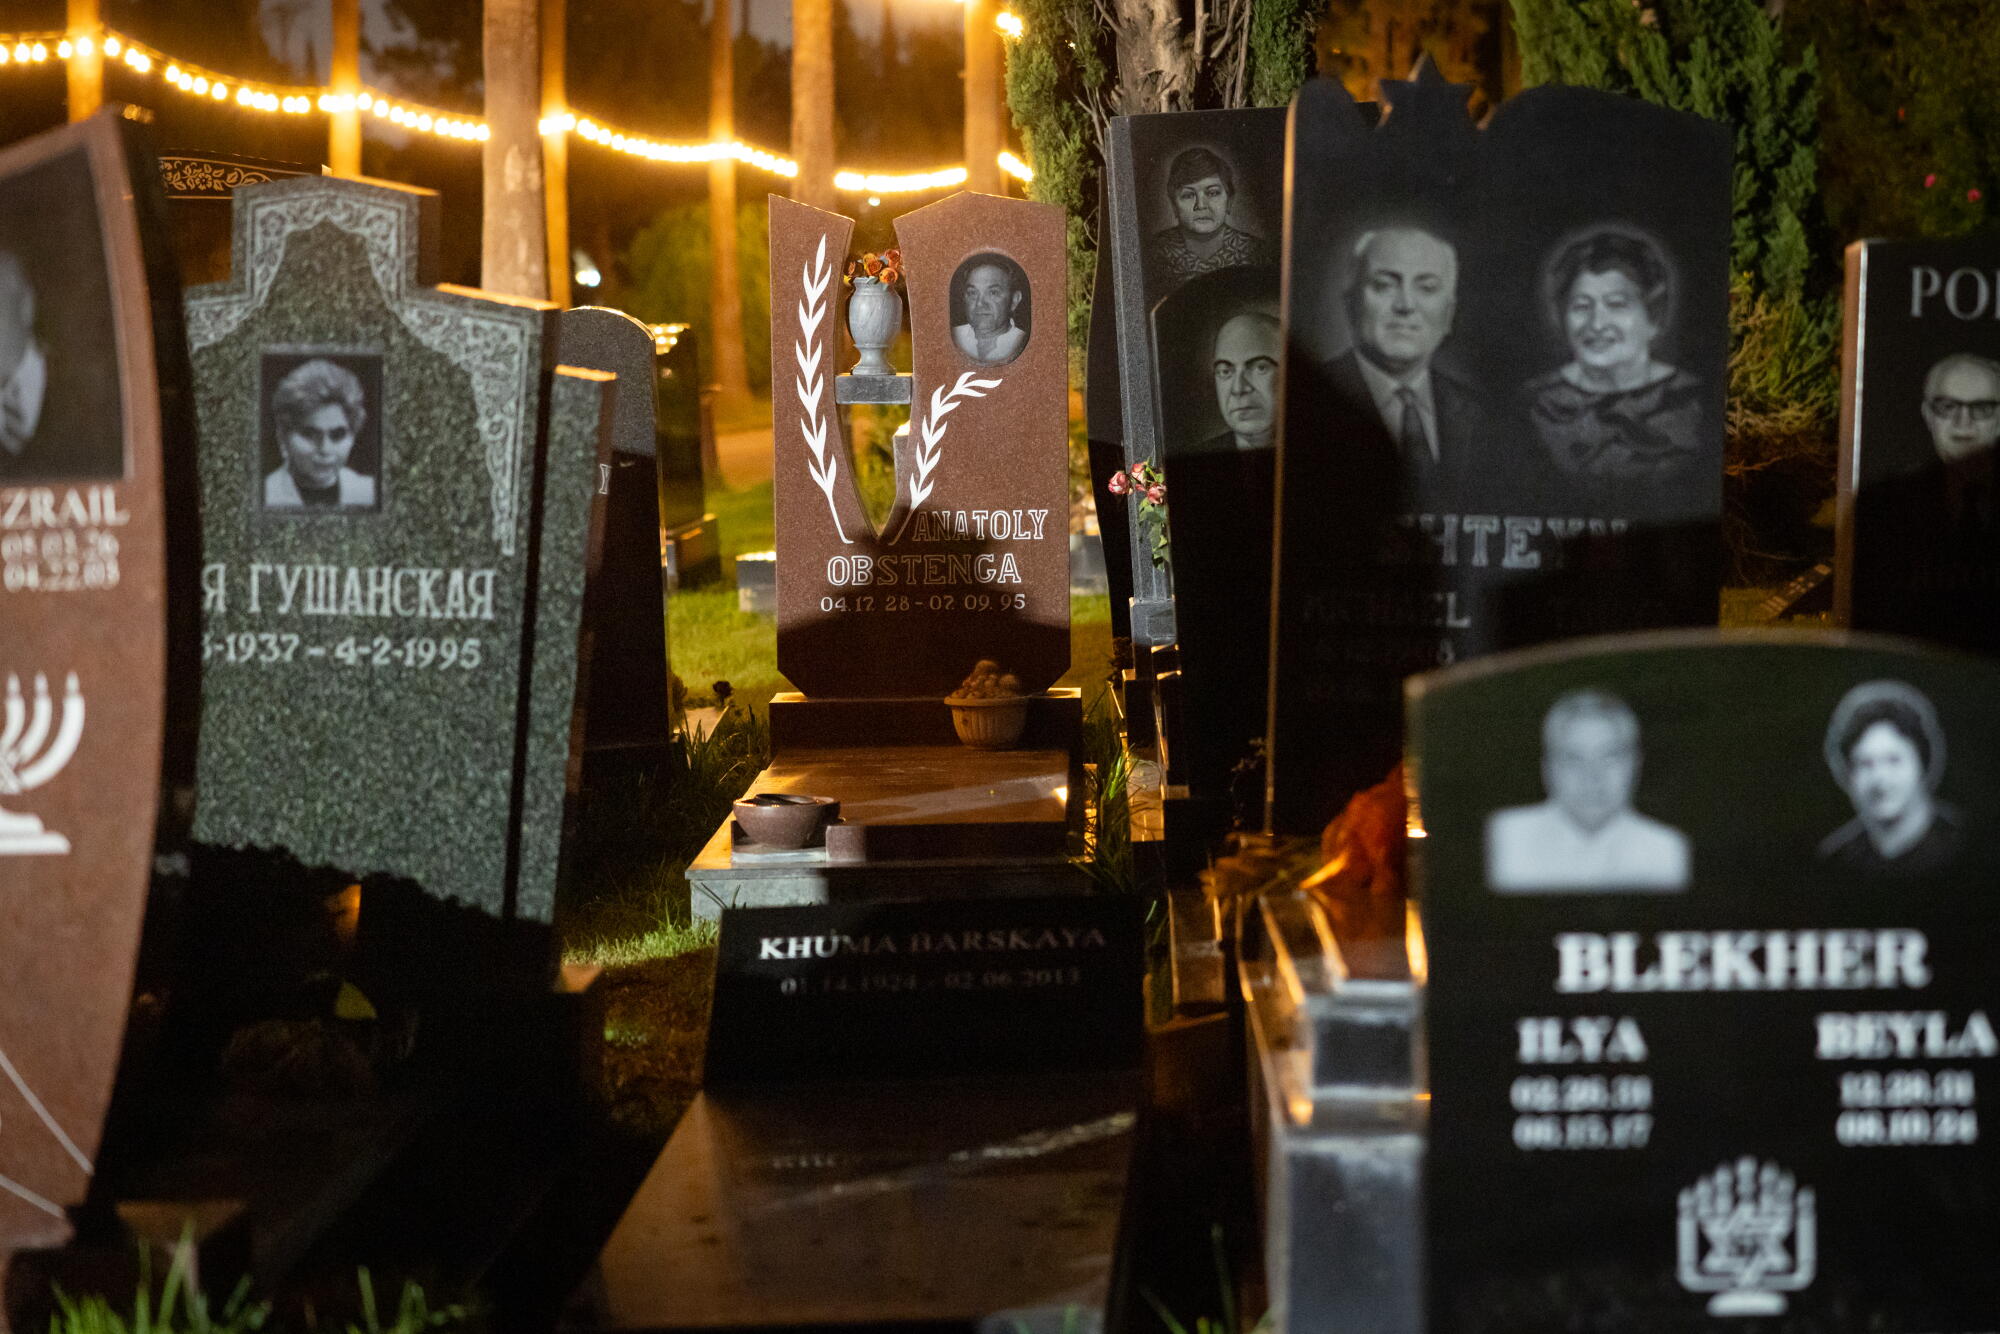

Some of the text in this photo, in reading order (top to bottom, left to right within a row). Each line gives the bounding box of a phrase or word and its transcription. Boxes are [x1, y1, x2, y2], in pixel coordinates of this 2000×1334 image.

[1910, 265, 2000, 320] PO
[1, 485, 130, 528] ZRAIL
[912, 510, 1048, 541] ANATOLY
[202, 563, 496, 619] Я ГУШАНСКАЯ
[828, 553, 1021, 586] OBSTENGA
[335, 635, 482, 670] 4-2-1995
[758, 927, 1107, 960] KHUMA BARSKAYA
[1555, 929, 1932, 992] BLEKHER
[1517, 1016, 1648, 1063] ILYA
[1815, 1010, 1999, 1060] BEYLA
